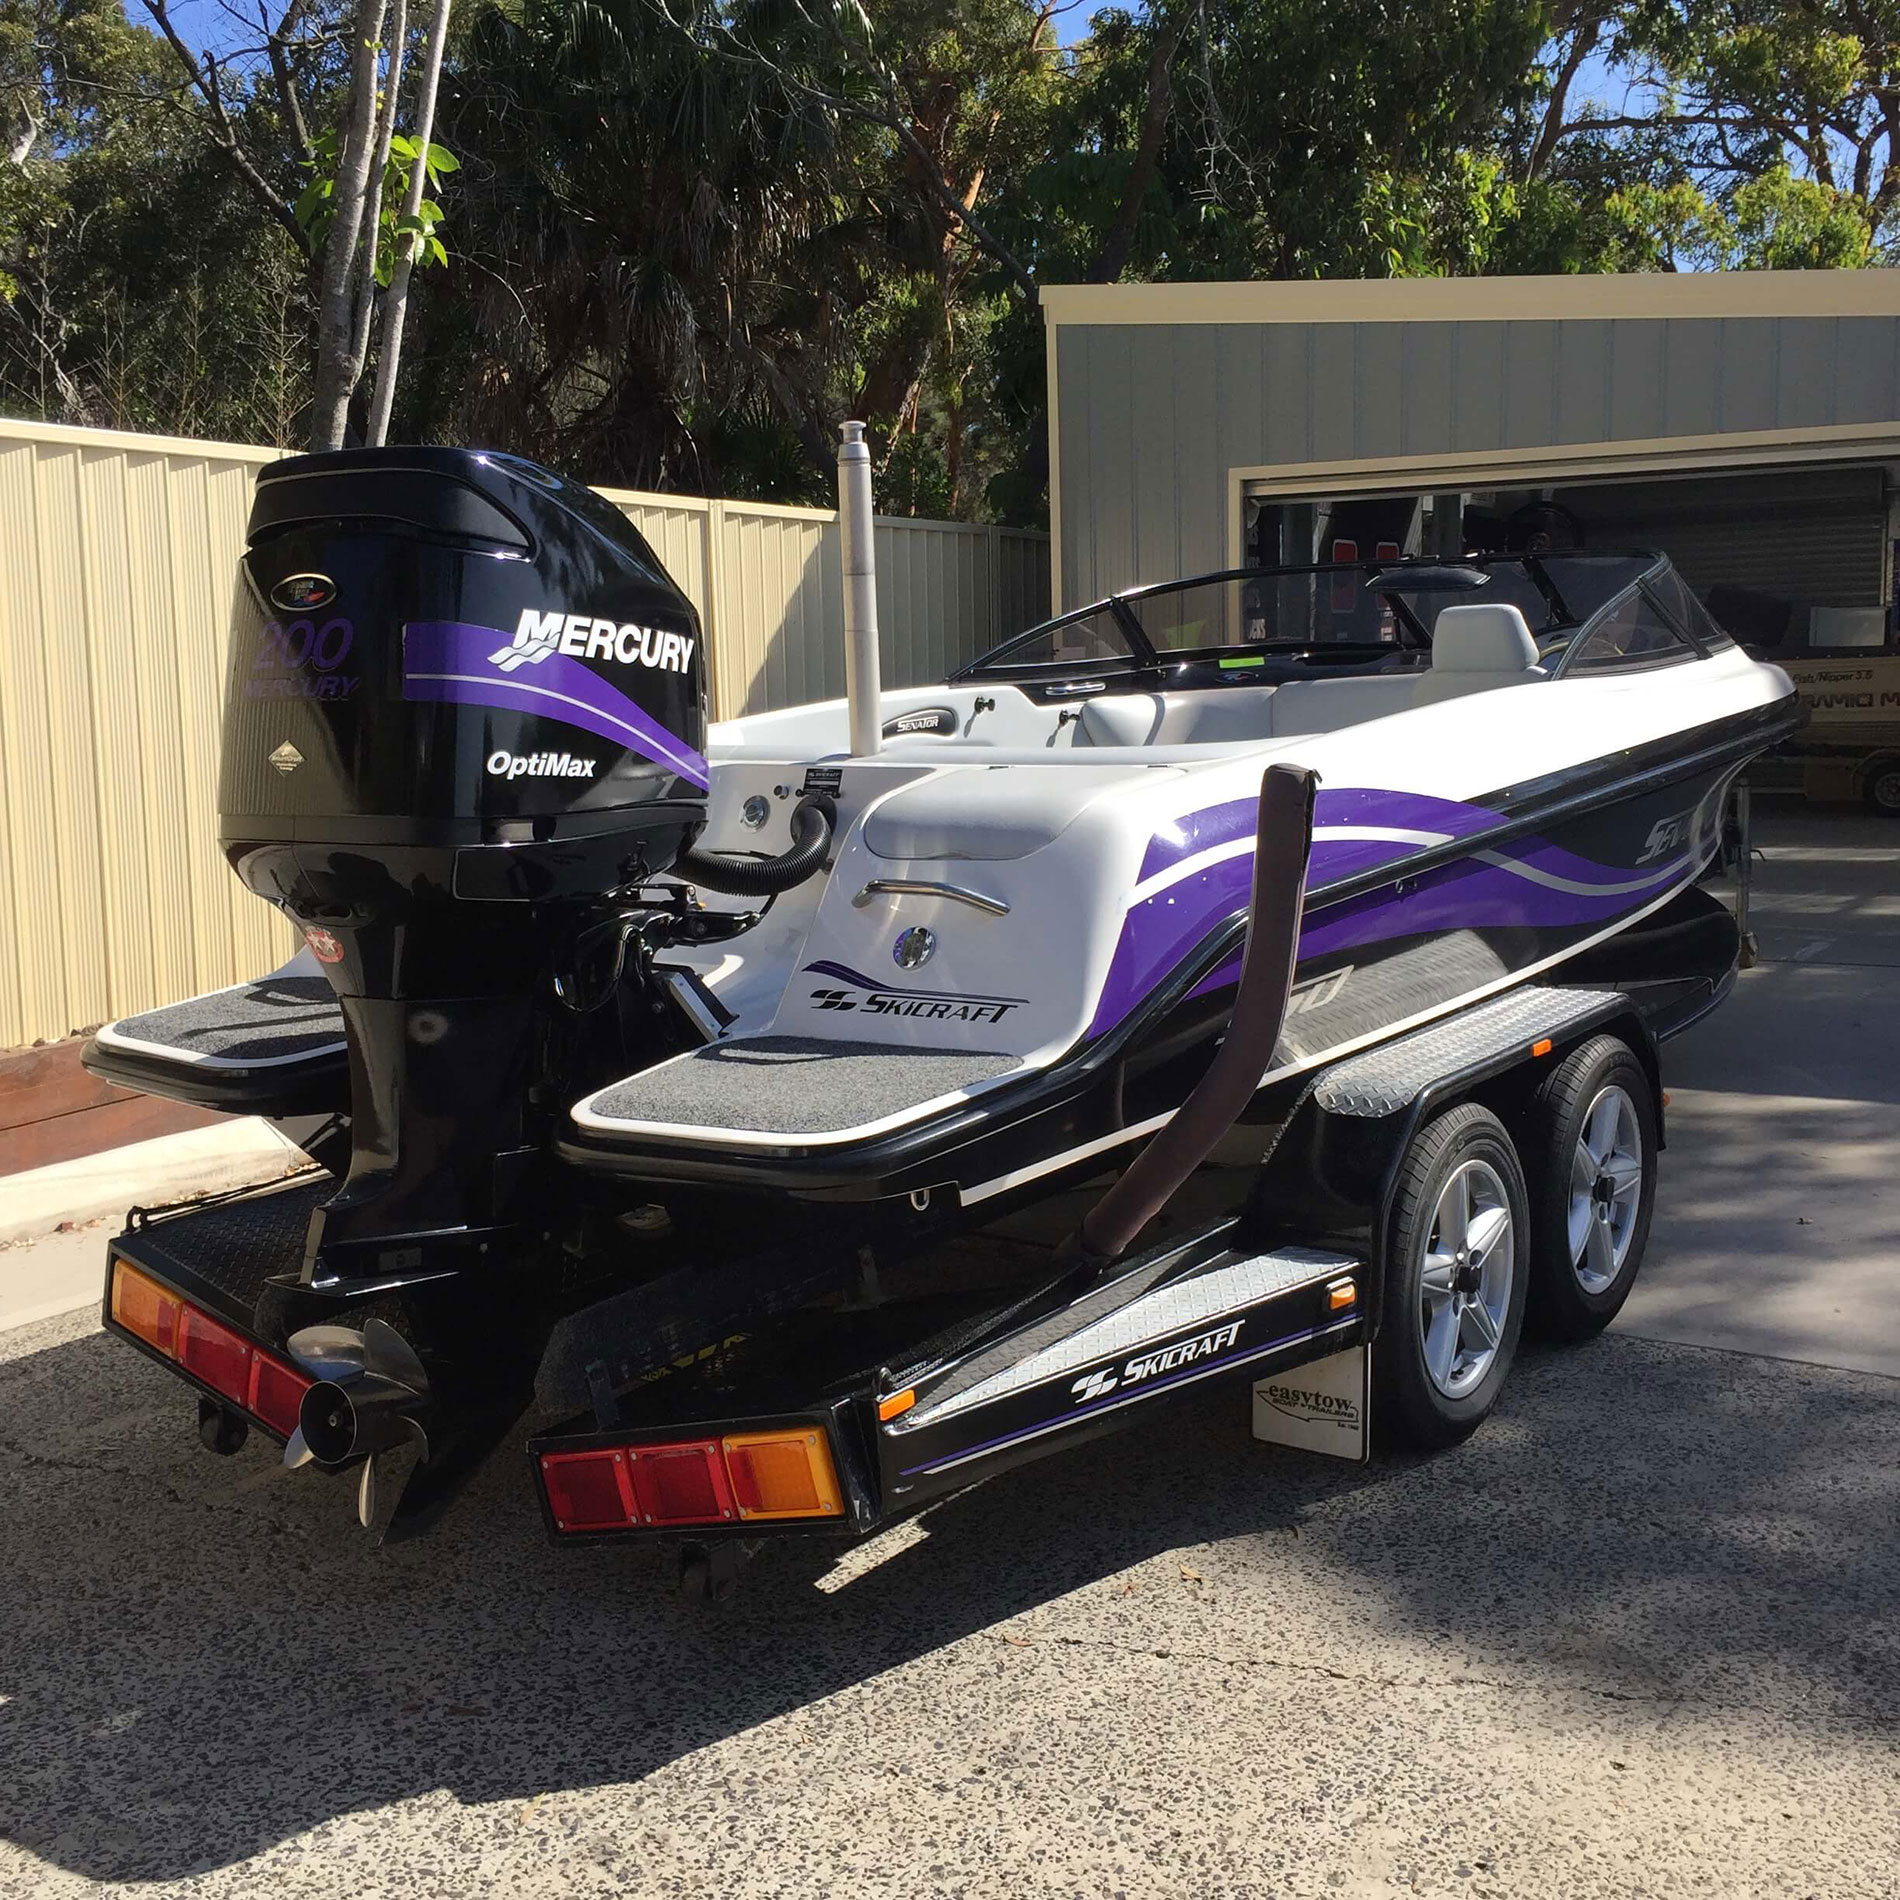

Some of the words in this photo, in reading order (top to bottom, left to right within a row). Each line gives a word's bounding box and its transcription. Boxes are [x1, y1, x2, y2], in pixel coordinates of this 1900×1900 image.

[254, 617, 354, 673] 200
[512, 609, 695, 675] MERCURY
[246, 675, 360, 699] MERCURY
[894, 716, 939, 733] SENATOR
[487, 751, 597, 781] OptiMax
[860, 994, 1018, 1024] SKICRAFT
[1121, 1319, 1245, 1386] SKICRAFT
[1268, 1385, 1353, 1412] easytow
[1272, 1398, 1298, 1408] BOAT
